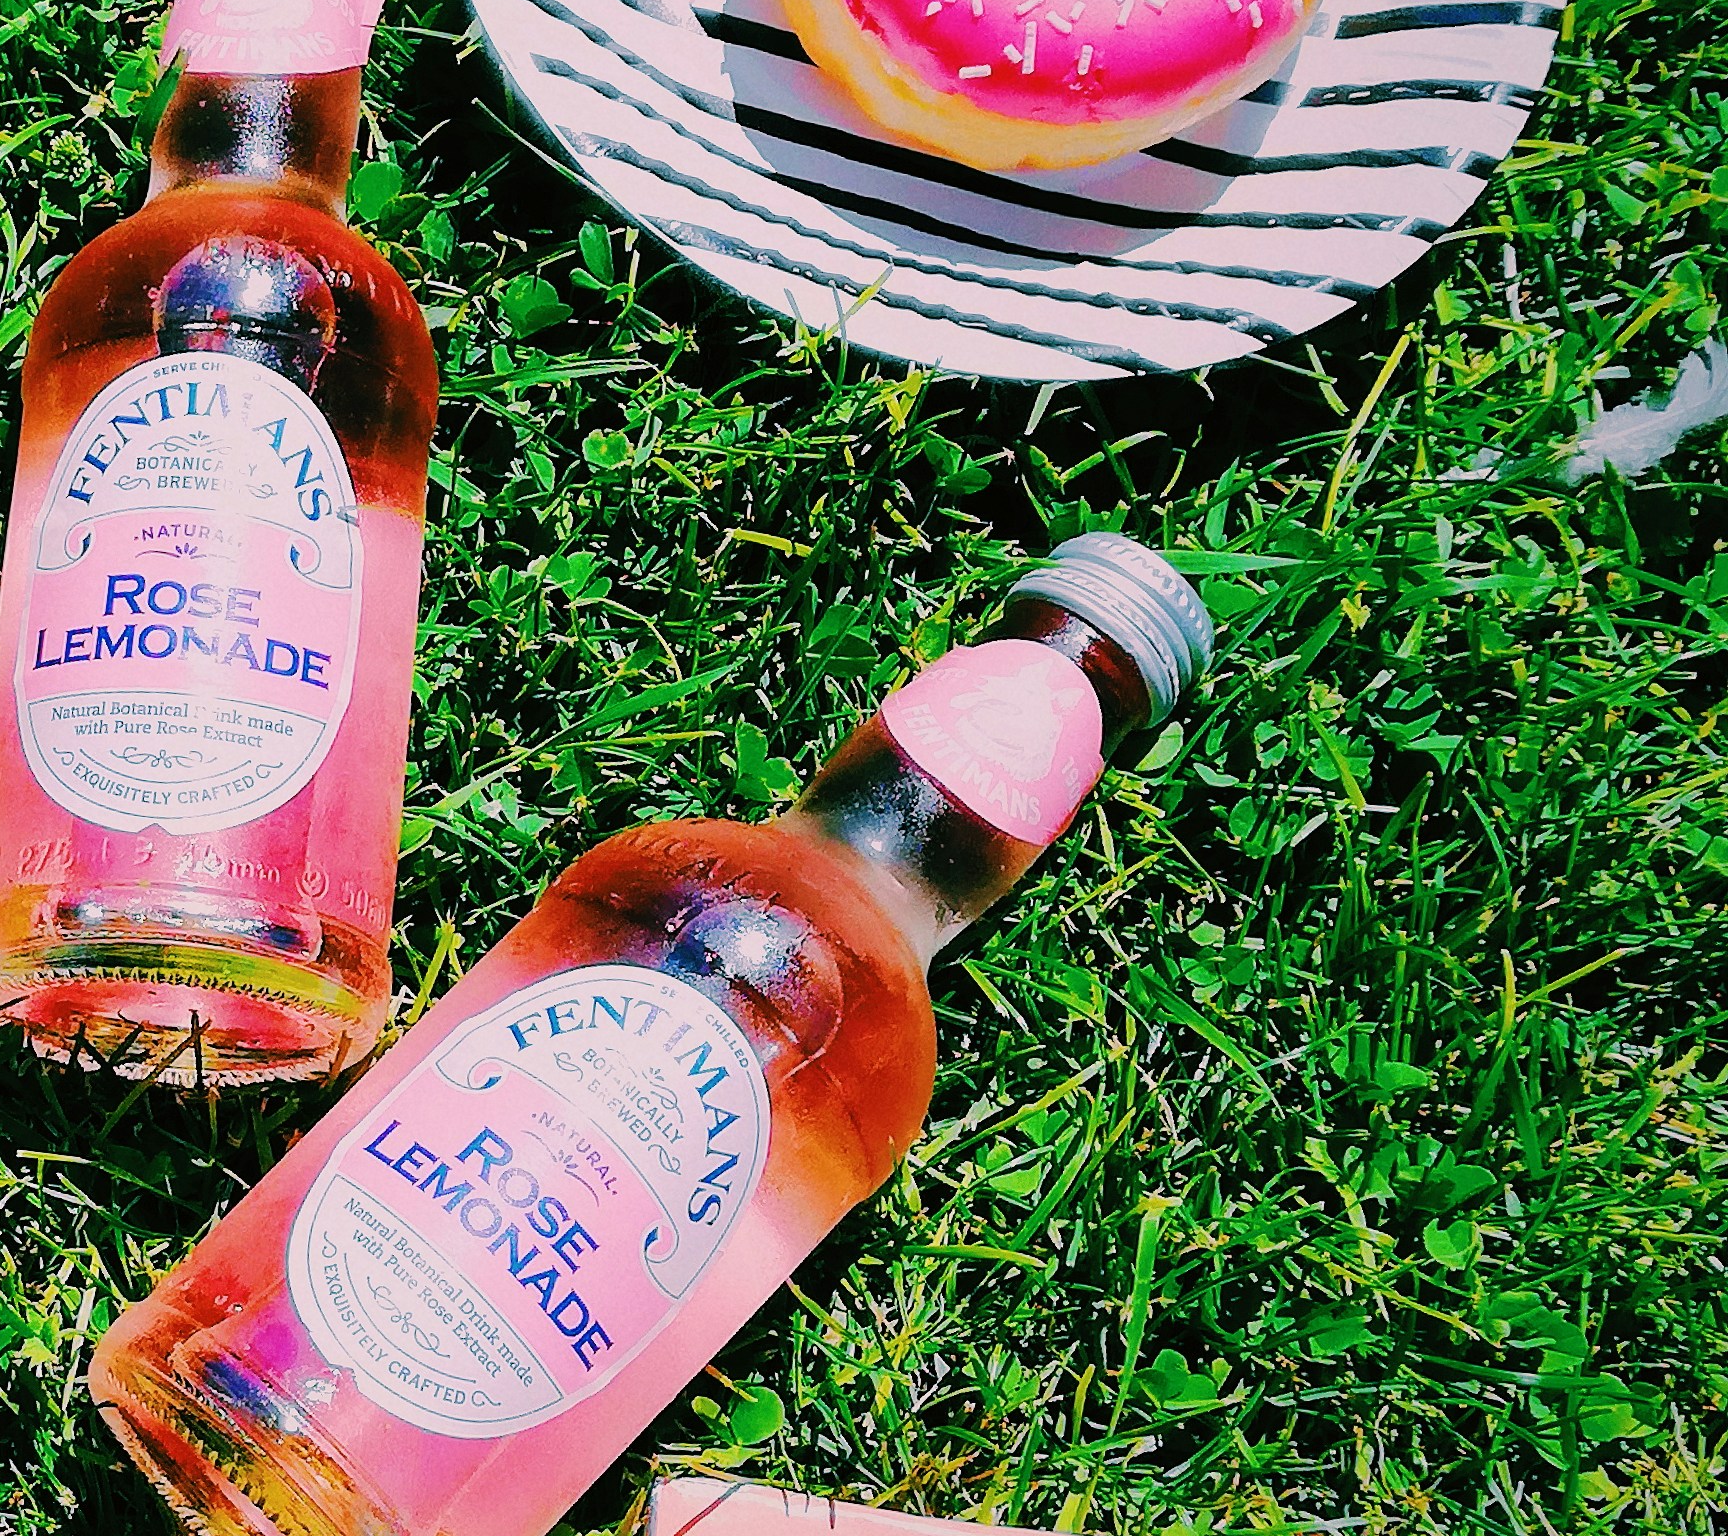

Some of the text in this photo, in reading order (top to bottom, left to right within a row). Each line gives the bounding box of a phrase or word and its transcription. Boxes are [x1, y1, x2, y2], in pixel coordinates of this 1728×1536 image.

[153, 361, 197, 379] SERVE
[103, 573, 262, 628] ROSE
[32, 623, 333, 691] LEMONADE
[50, 701, 107, 722] Natural
[109, 700, 189, 719] Botanical
[247, 715, 295, 737] made
[74, 718, 264, 749] with Pure Rose Extract
[72, 762, 255, 806] EXQUISITELY CRAFTED
[900, 703, 1041, 826] FENTIMANS
[705, 1014, 750, 1069] CHILLED
[506, 995, 742, 1226] FENTIMANS
[587, 1078, 653, 1143] BREWED
[538, 1111, 617, 1192] NATURAL
[454, 1125, 600, 1275] ROSE
[362, 1119, 615, 1373] LEMONADE
[343, 1197, 536, 1388] Natural Botanical Drink made
[352, 1228, 502, 1379] with Pure Rose Extract
[323, 1263, 466, 1406] EXQUISITELY CRAFTED
